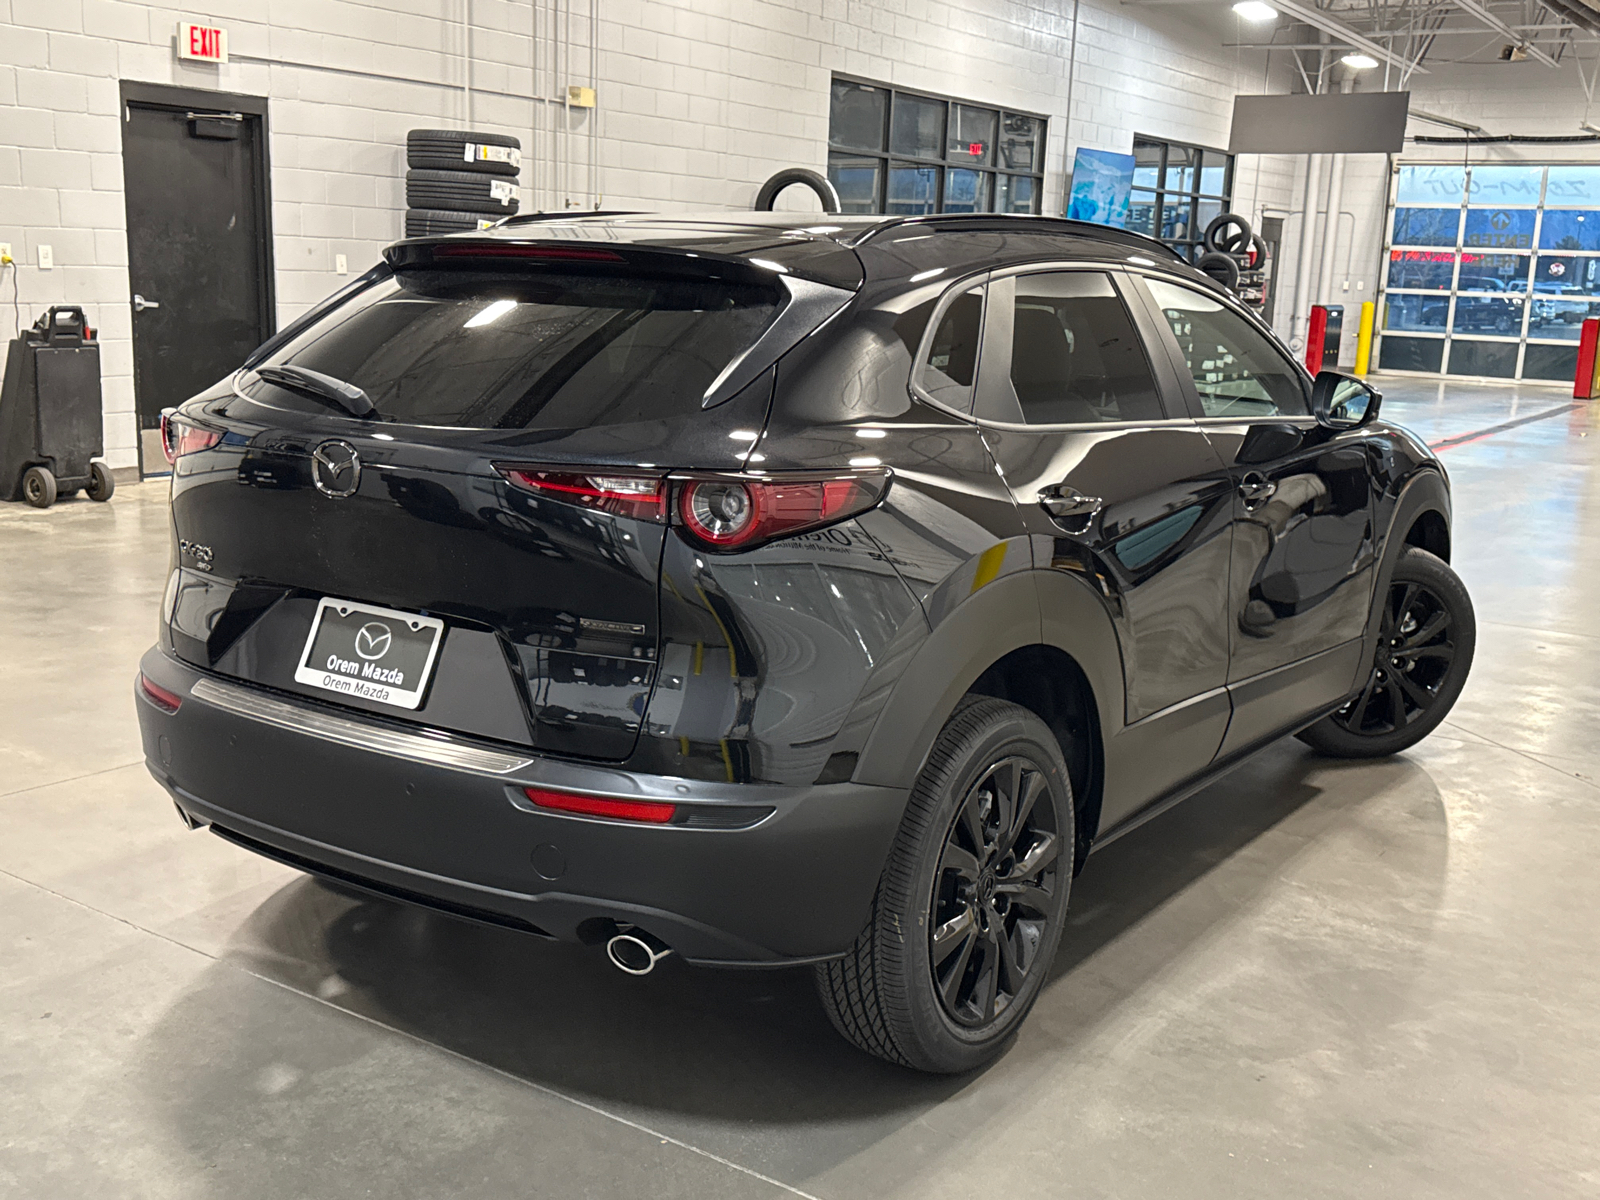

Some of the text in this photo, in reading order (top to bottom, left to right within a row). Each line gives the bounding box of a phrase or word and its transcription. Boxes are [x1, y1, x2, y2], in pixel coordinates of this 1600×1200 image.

[190, 25, 221, 59] EXIT
[326, 654, 404, 685] Orem Mazda
[322, 675, 390, 701] Orem Mazda
